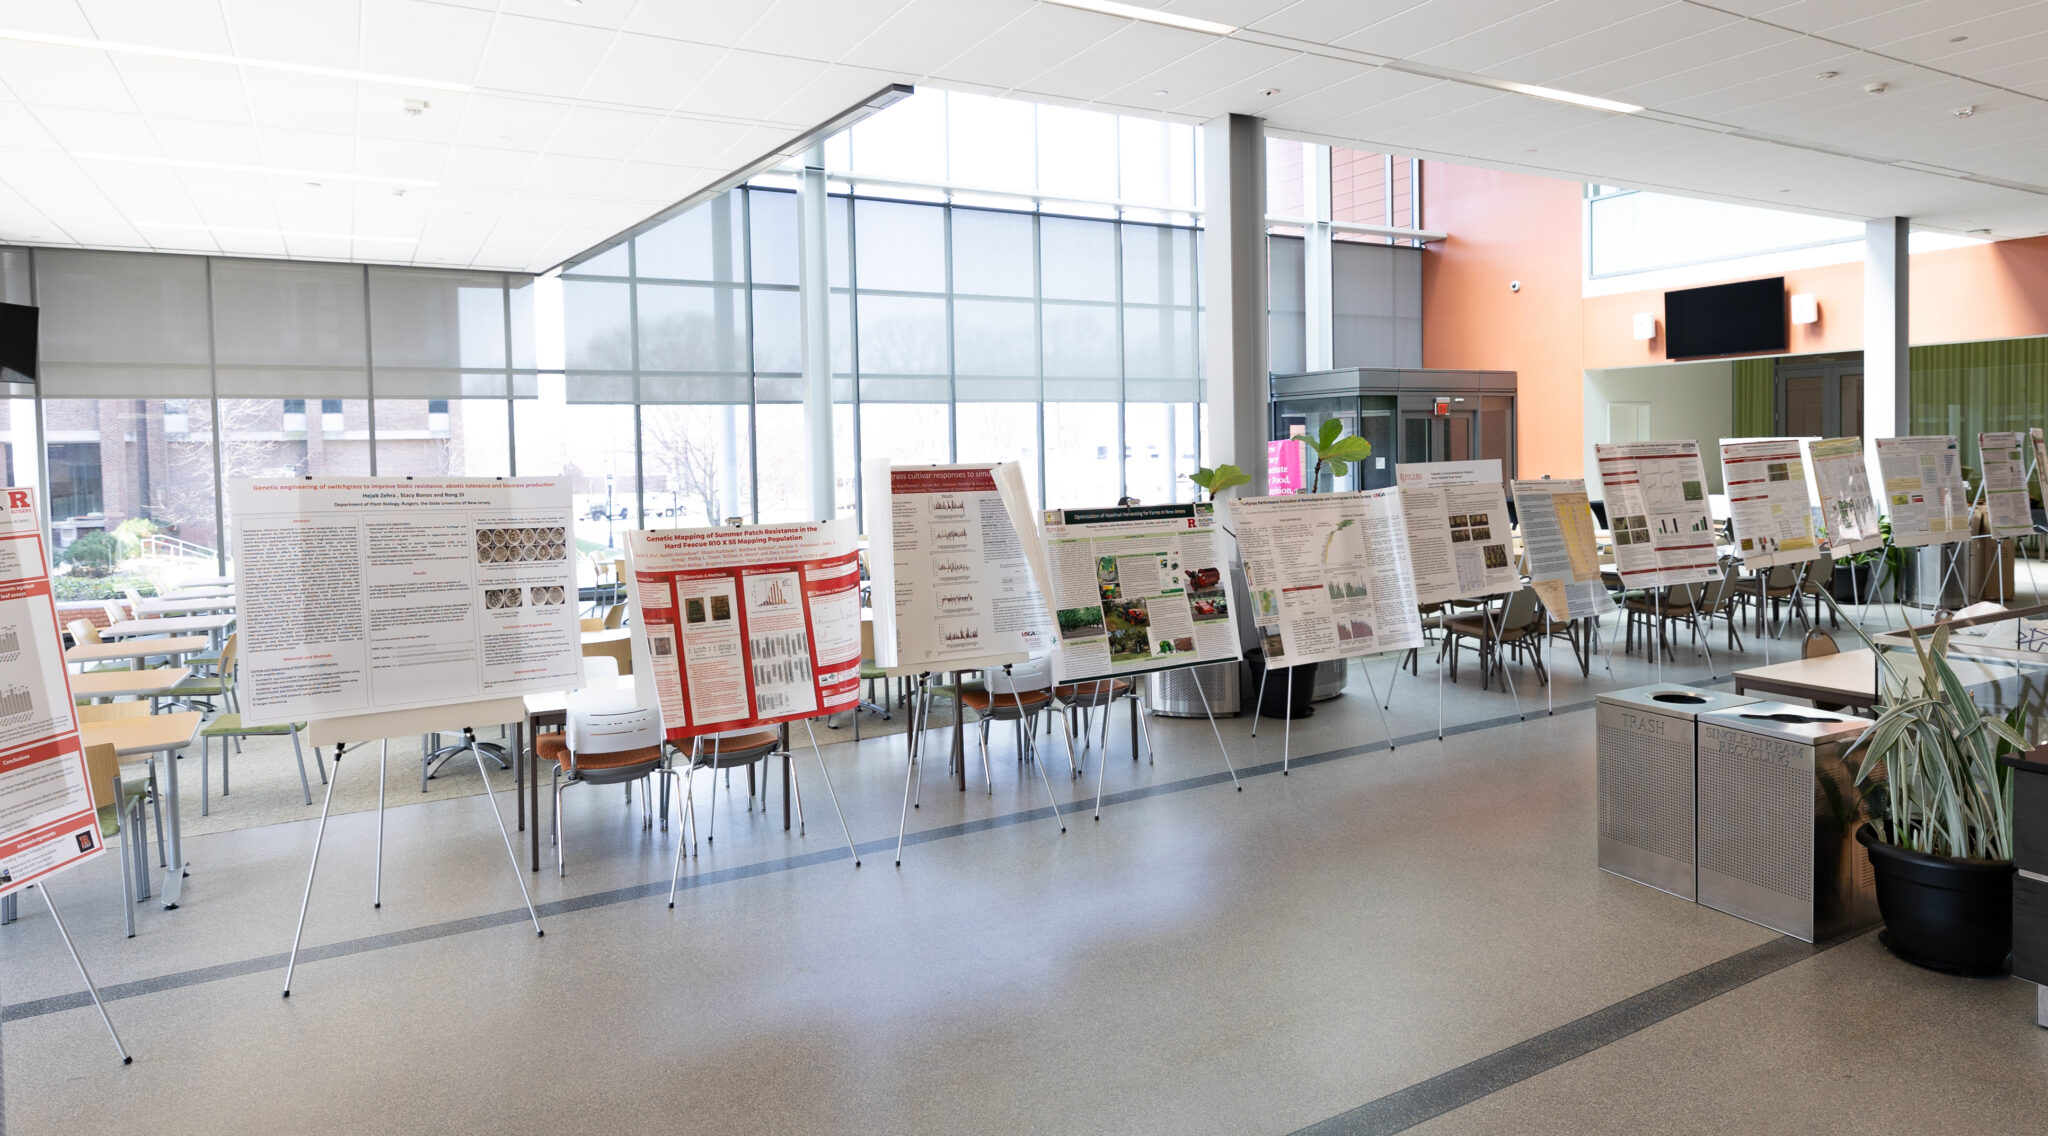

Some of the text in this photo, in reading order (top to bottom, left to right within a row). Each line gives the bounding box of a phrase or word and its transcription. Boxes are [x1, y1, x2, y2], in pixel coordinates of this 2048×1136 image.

[8, 491, 30, 508] R
[1188, 519, 1196, 528] R
[674, 533, 704, 541] Mapping
[1622, 713, 1664, 734] TRASH
[1705, 727, 1804, 758] SINGLE STREAM
[3, 754, 30, 766] Conclusions
[1718, 741, 1790, 767] RECYCLING
